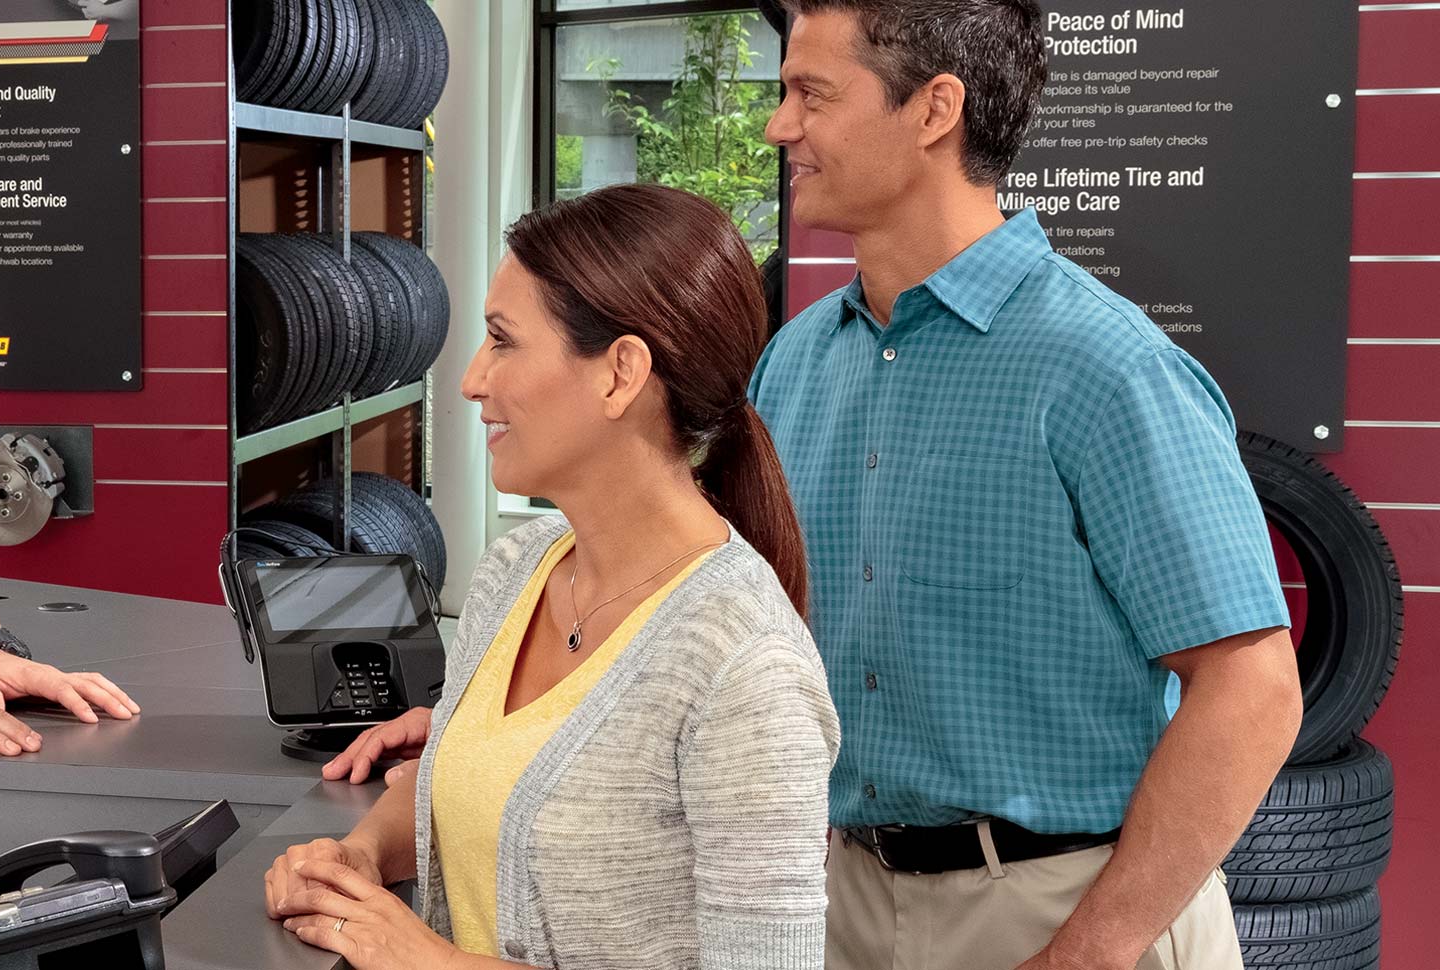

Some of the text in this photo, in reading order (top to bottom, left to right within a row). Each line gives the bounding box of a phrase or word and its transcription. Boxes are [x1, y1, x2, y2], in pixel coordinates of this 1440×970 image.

[1048, 9, 1184, 31] Peace of Mind
[1045, 36, 1137, 55] Protection
[1051, 68, 1219, 83] tire is damaged beyond repair
[15, 86, 56, 102] Quality
[1085, 85, 1098, 94] its
[1101, 84, 1130, 94] value
[1115, 103, 1124, 113] is
[1127, 103, 1191, 115] guaranteed
[1195, 102, 1211, 112] for
[1214, 102, 1233, 112] the
[1044, 120, 1069, 130] your
[1072, 118, 1095, 127] tires
[42, 127, 80, 135] experience
[0, 141, 46, 150] professionally
[1023, 135, 1208, 149] e offer free pre-trip safety checks
[7, 154, 30, 162] quality
[32, 153, 49, 162] parts
[1007, 167, 1203, 187] ree Lifetime Tire and
[20, 177, 42, 191] and
[22, 193, 67, 208] Service
[997, 191, 1120, 214] Mileage Care
[3, 232, 33, 240] warranty
[1057, 227, 1073, 236] tire
[1077, 226, 1114, 238] repairs
[3, 245, 52, 253] appointments
[1057, 245, 1104, 255] rotations
[1152, 302, 1192, 312] checks
